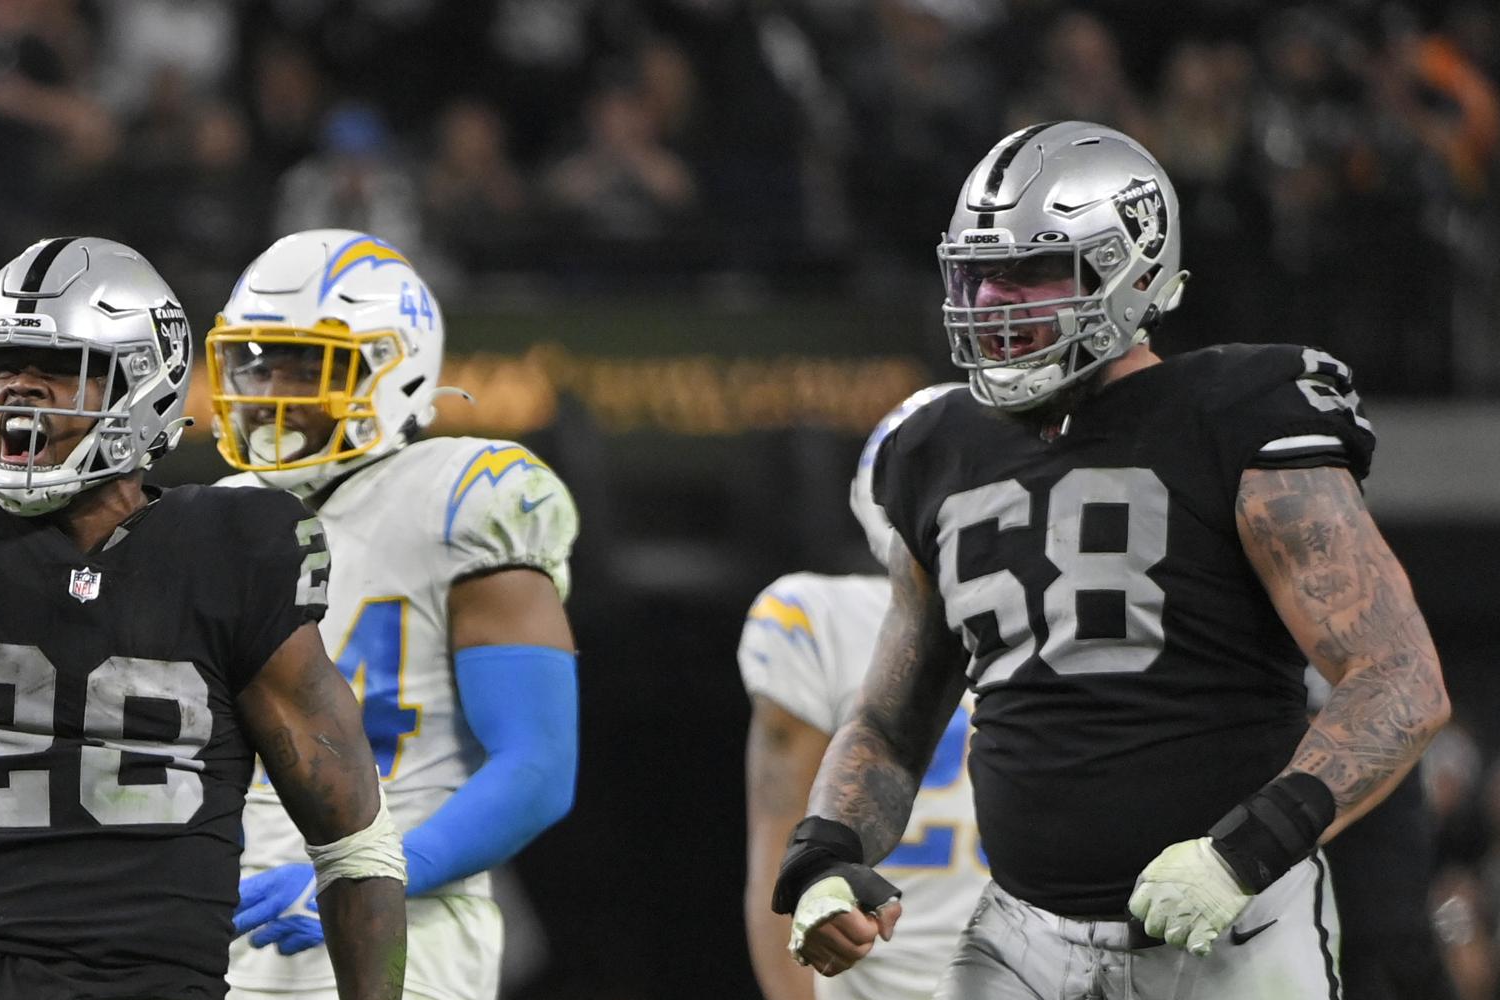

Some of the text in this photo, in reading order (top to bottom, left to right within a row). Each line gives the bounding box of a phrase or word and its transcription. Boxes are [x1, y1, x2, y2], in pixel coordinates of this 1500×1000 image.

[965, 235, 1000, 244] RAIDERS
[399, 282, 433, 331] 44
[74, 581, 94, 594] NFL
[938, 467, 1169, 688] 68
